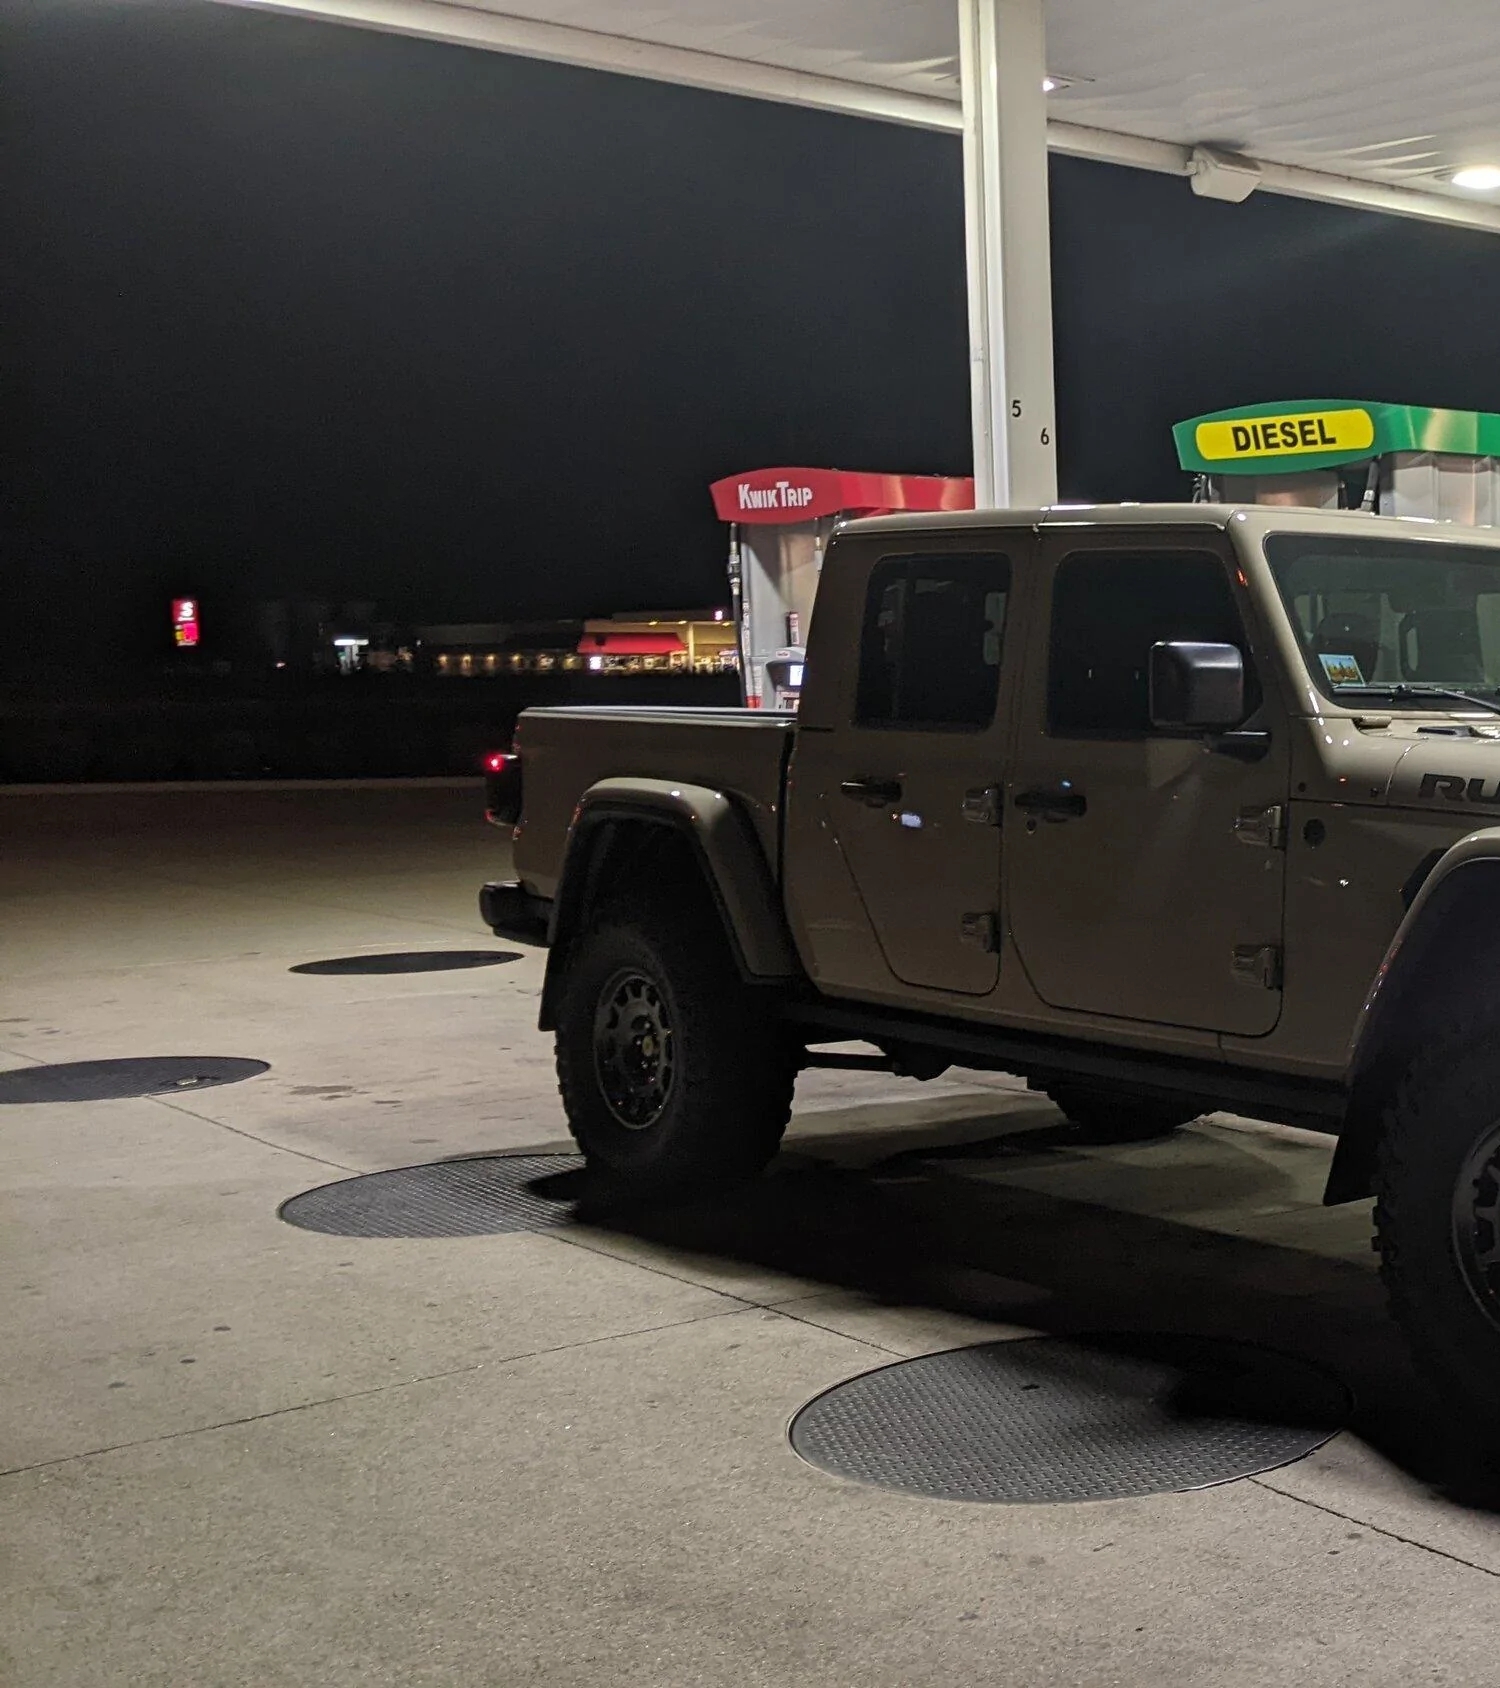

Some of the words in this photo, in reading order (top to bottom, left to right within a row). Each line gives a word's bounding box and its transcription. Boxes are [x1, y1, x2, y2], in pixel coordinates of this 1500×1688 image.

[1012, 399, 1022, 418] 5
[1040, 427, 1050, 446] 6
[1231, 418, 1338, 452] DIESEL
